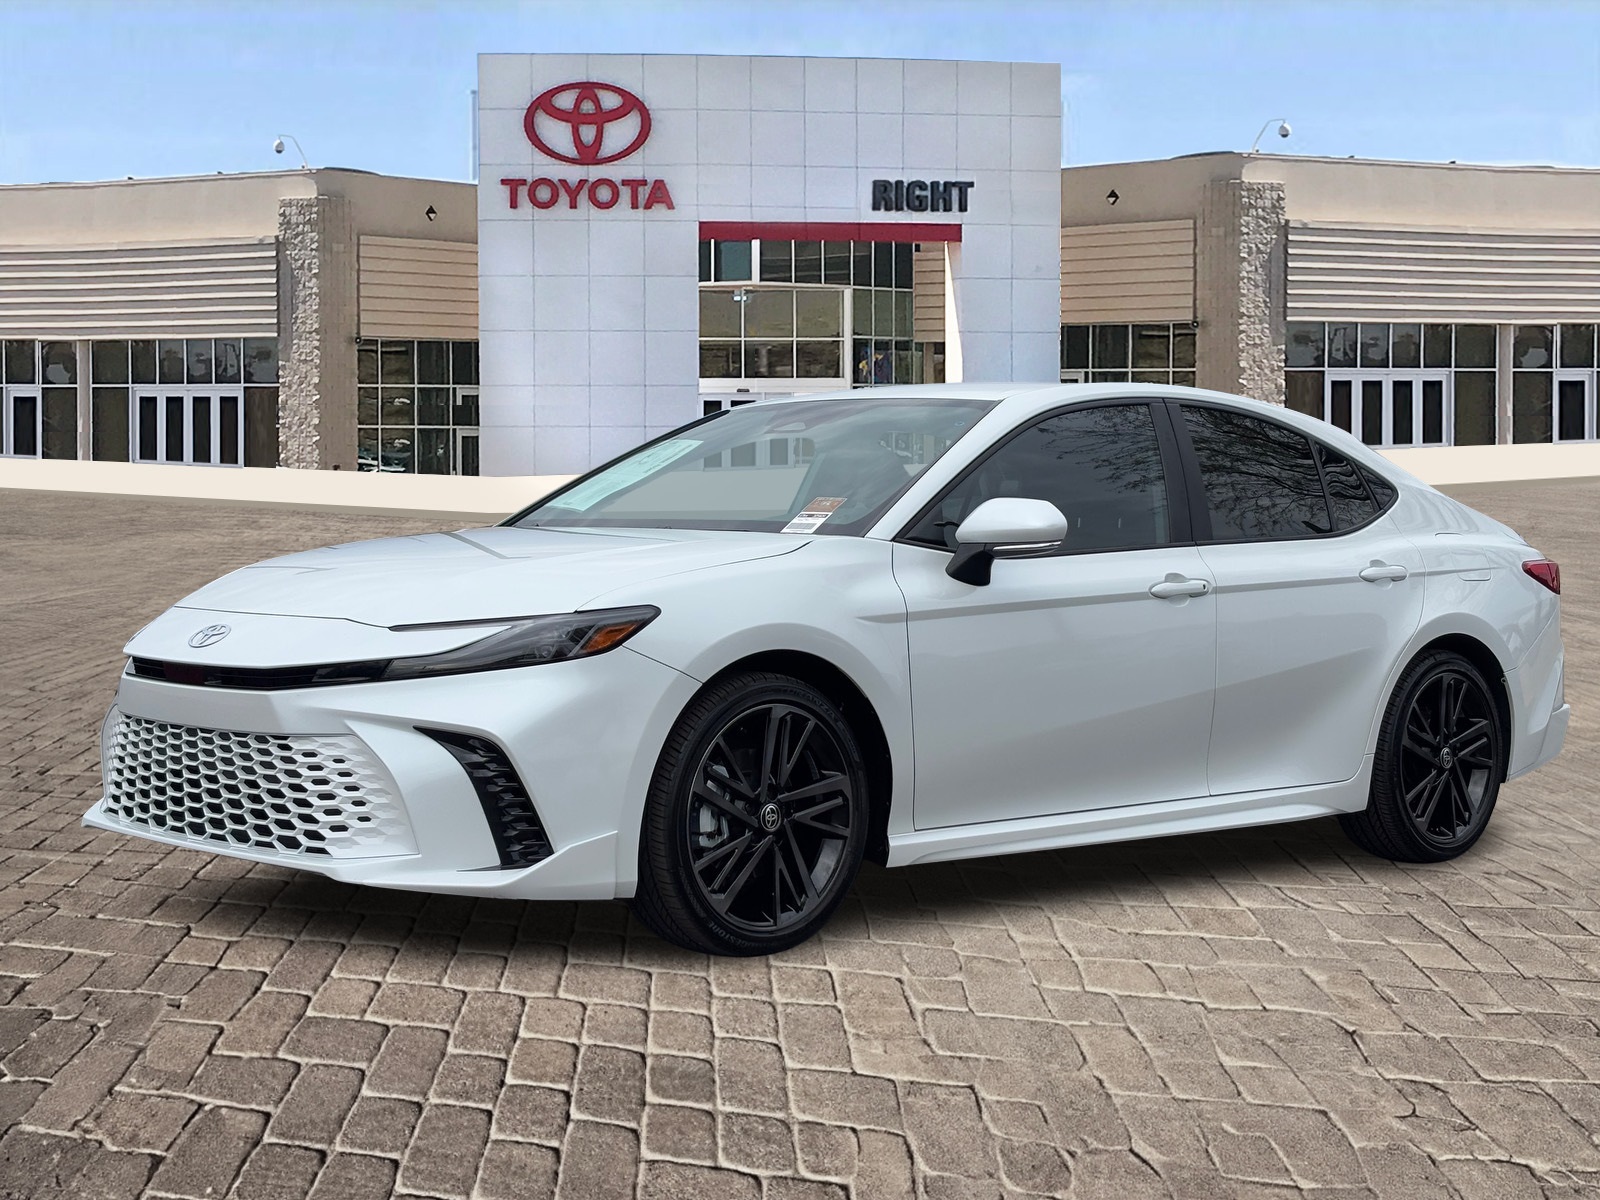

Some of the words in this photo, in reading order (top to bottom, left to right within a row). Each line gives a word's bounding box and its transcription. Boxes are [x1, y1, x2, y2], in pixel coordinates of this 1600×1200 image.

[500, 177, 675, 210] TOYOTA
[872, 179, 975, 212] RIGHT
[708, 920, 769, 948] DGESTONE
